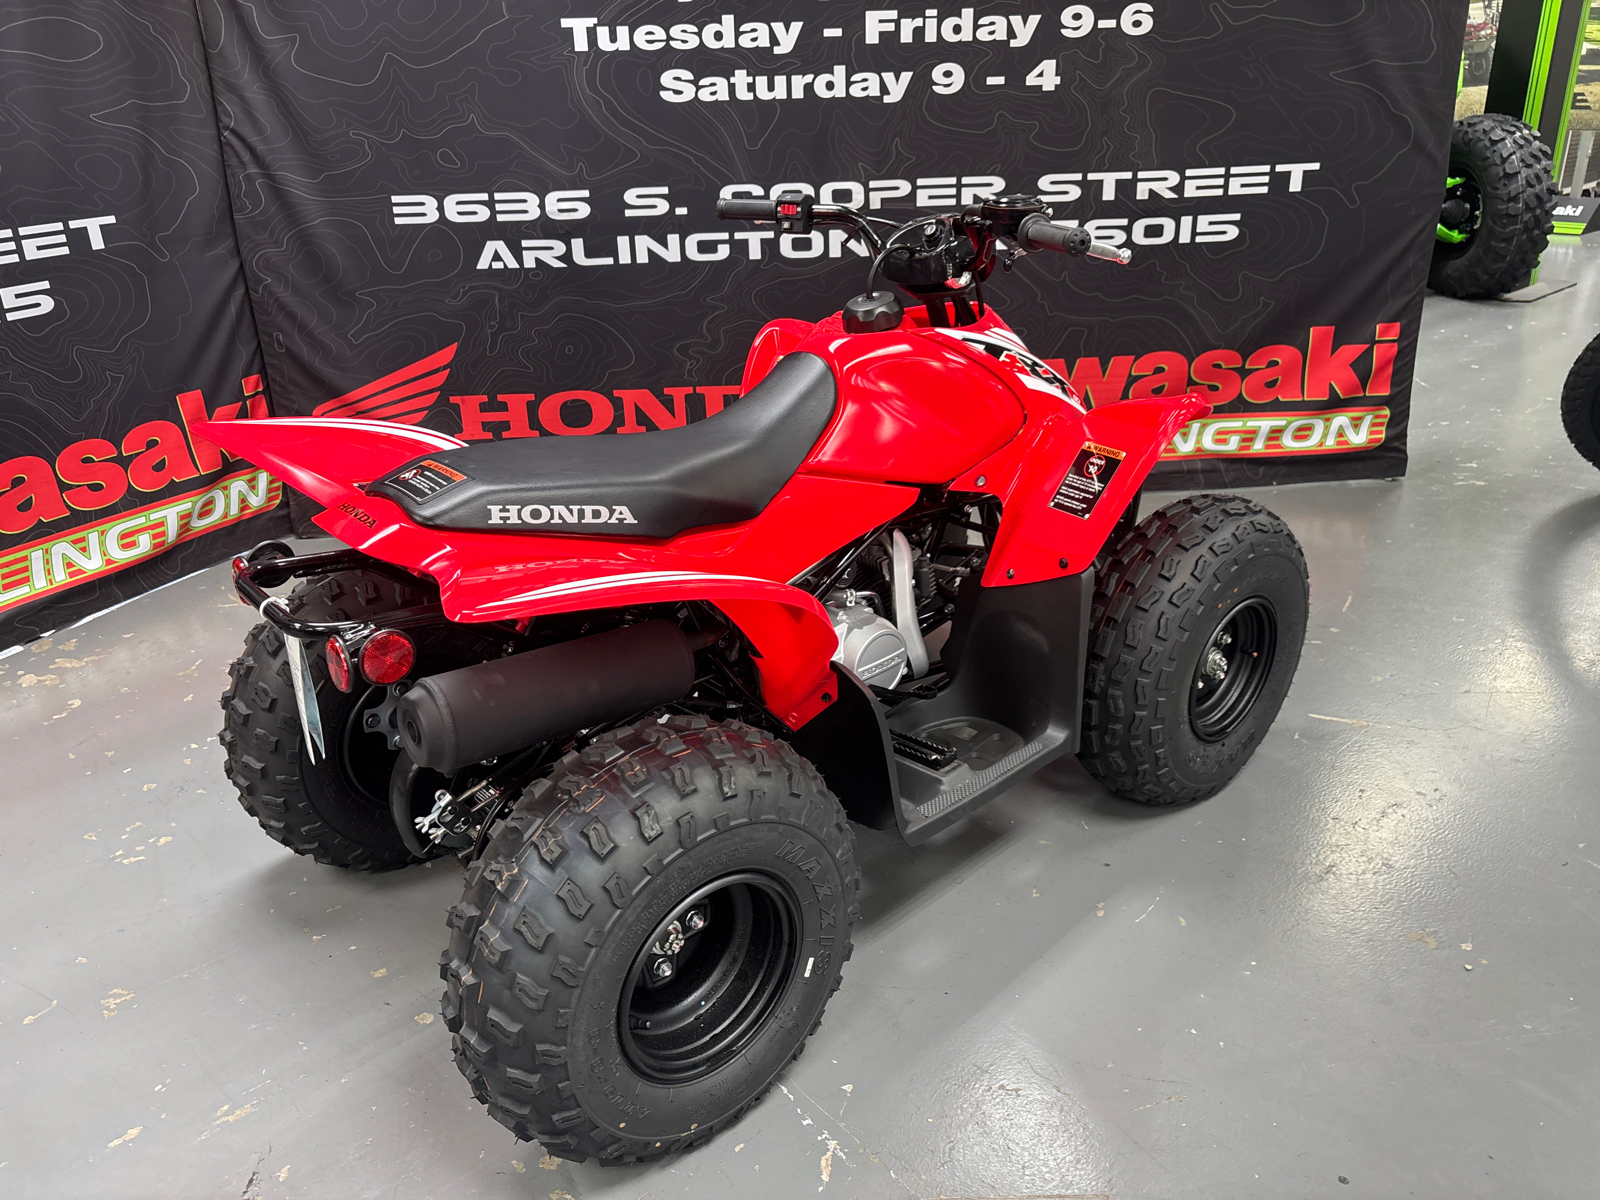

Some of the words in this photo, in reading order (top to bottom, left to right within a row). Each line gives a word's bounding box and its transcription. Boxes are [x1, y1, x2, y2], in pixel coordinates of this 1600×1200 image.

[560, 14, 804, 54] Tuesday
[864, 7, 1041, 48] Friday
[1059, 3, 1154, 36] 9-6
[659, 63, 913, 104] Saturday
[930, 62, 966, 94] 9
[1024, 59, 1062, 92] 4
[391, 189, 592, 225] 3636
[624, 186, 688, 217] S.
[1036, 162, 1321, 202] STREET
[475, 229, 871, 270] ARLINGTON
[336, 502, 378, 529] HONDA
[487, 504, 638, 524] HONDA
[774, 839, 836, 976] MAXXIS
